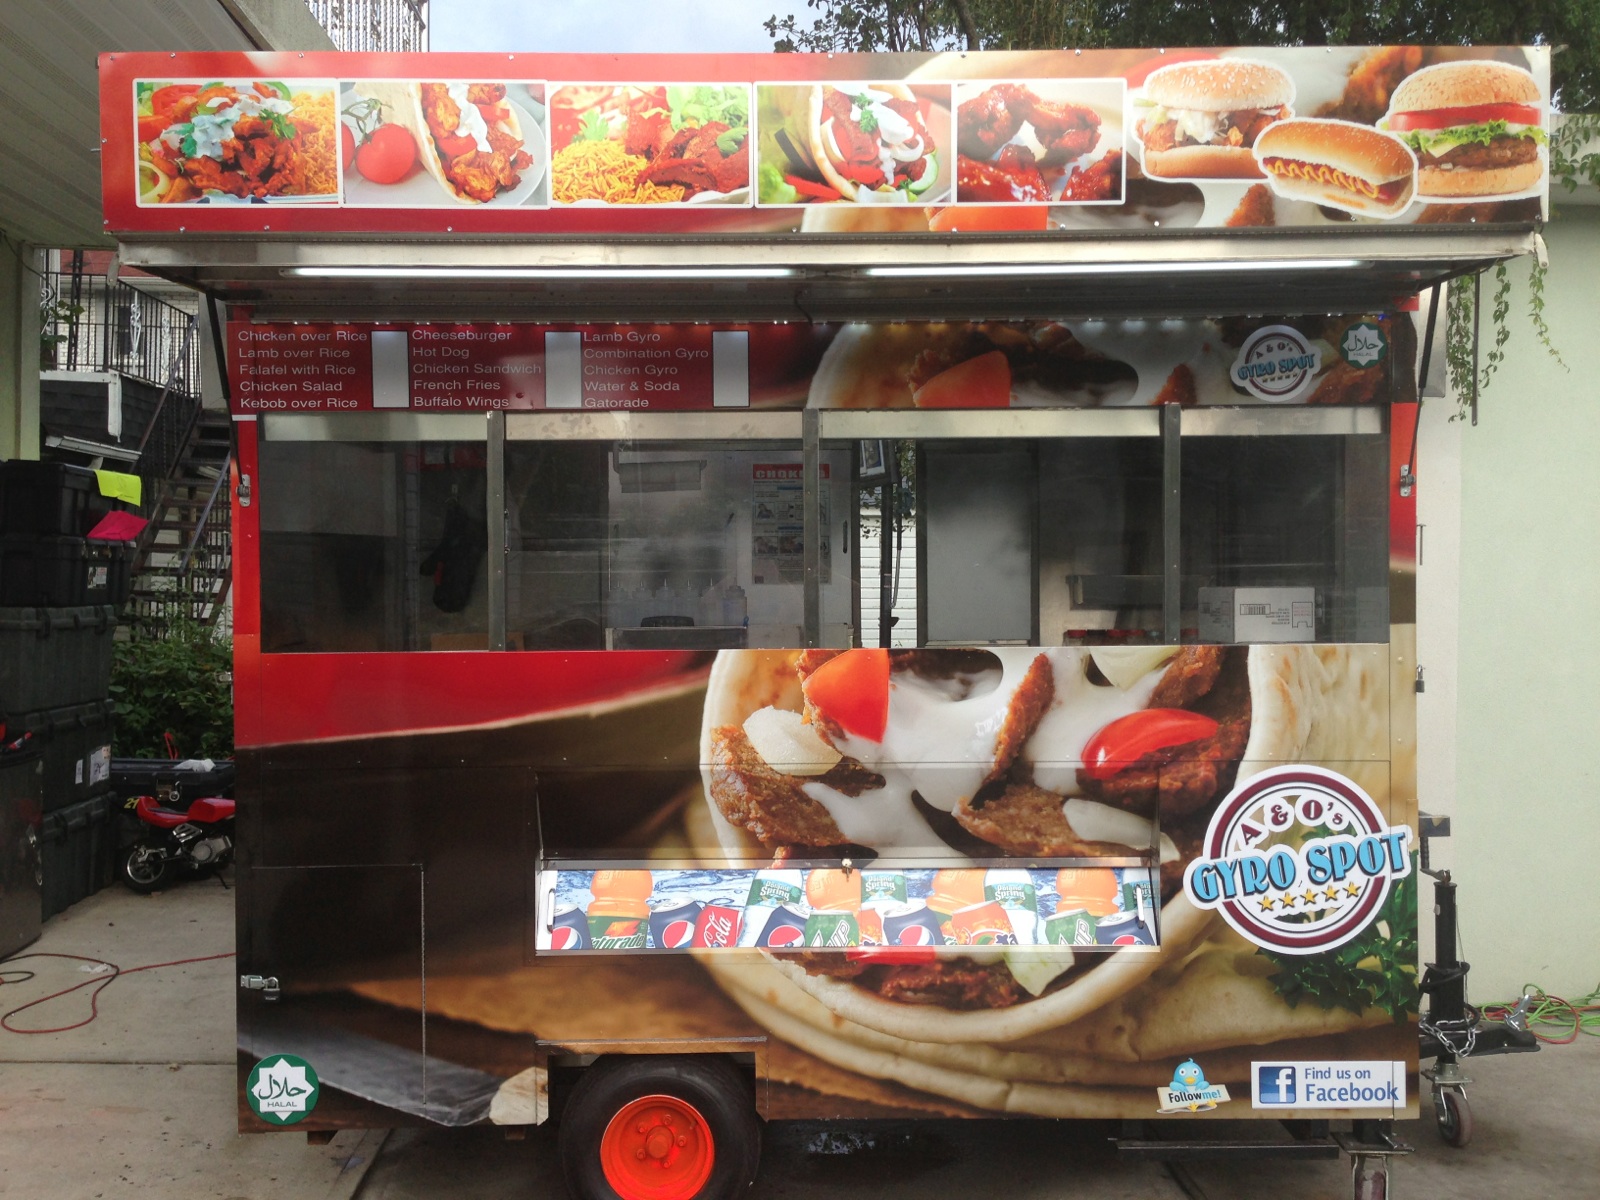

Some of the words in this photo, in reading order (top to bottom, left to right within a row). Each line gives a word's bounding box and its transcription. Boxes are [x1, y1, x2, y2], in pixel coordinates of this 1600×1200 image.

[238, 330, 296, 341] Chicken
[300, 333, 330, 341] over
[336, 330, 367, 341] Rice
[412, 330, 512, 342] Cheeseburger
[583, 331, 623, 342] Lamb
[627, 332, 661, 345] Gyro
[1348, 334, 1379, 351] حلال
[239, 348, 278, 358] Lamb
[284, 350, 315, 358] over
[319, 348, 350, 358] Rice
[412, 347, 436, 357] Hot
[442, 347, 470, 359] Dog
[584, 348, 671, 359] Combination
[675, 348, 709, 361] Gyro
[1256, 351, 1264, 359] A
[1266, 343, 1273, 353] &
[239, 364, 288, 375] Falafel
[293, 364, 319, 375] with
[325, 364, 355, 375] Rice
[413, 364, 469, 374] Chicken
[474, 364, 541, 374] Sandwich
[584, 365, 640, 375] Chicken
[645, 365, 678, 377] Gyro
[1237, 361, 1276, 380] GYRO
[1278, 353, 1315, 373] SPOT
[240, 381, 297, 392] Chicken
[302, 381, 342, 392] Salad
[413, 380, 461, 390] French
[466, 379, 500, 390] Fries
[584, 381, 625, 391] Water
[630, 381, 639, 391] &
[644, 381, 680, 391] Soda
[240, 397, 288, 408] Kebob
[291, 400, 322, 408] over
[326, 398, 358, 408] Rice
[414, 396, 462, 407] Buffalo
[466, 396, 509, 409] Wings
[584, 398, 649, 408] Gatorade
[1241, 823, 1262, 845] A
[1271, 804, 1288, 826] &
[1302, 799, 1343, 825] O's
[1191, 851, 1296, 902] GYRO
[1306, 832, 1406, 885] SPOT
[865, 880, 896, 892] Spring
[760, 886, 790, 901] Spring
[995, 889, 1025, 901] Spring
[591, 932, 645, 949] atorade
[1304, 1067, 1331, 1079] Find
[1336, 1069, 1350, 1079] us
[1354, 1069, 1371, 1079] on
[258, 1074, 307, 1100] حلال
[1306, 1081, 1399, 1101] Facebook
